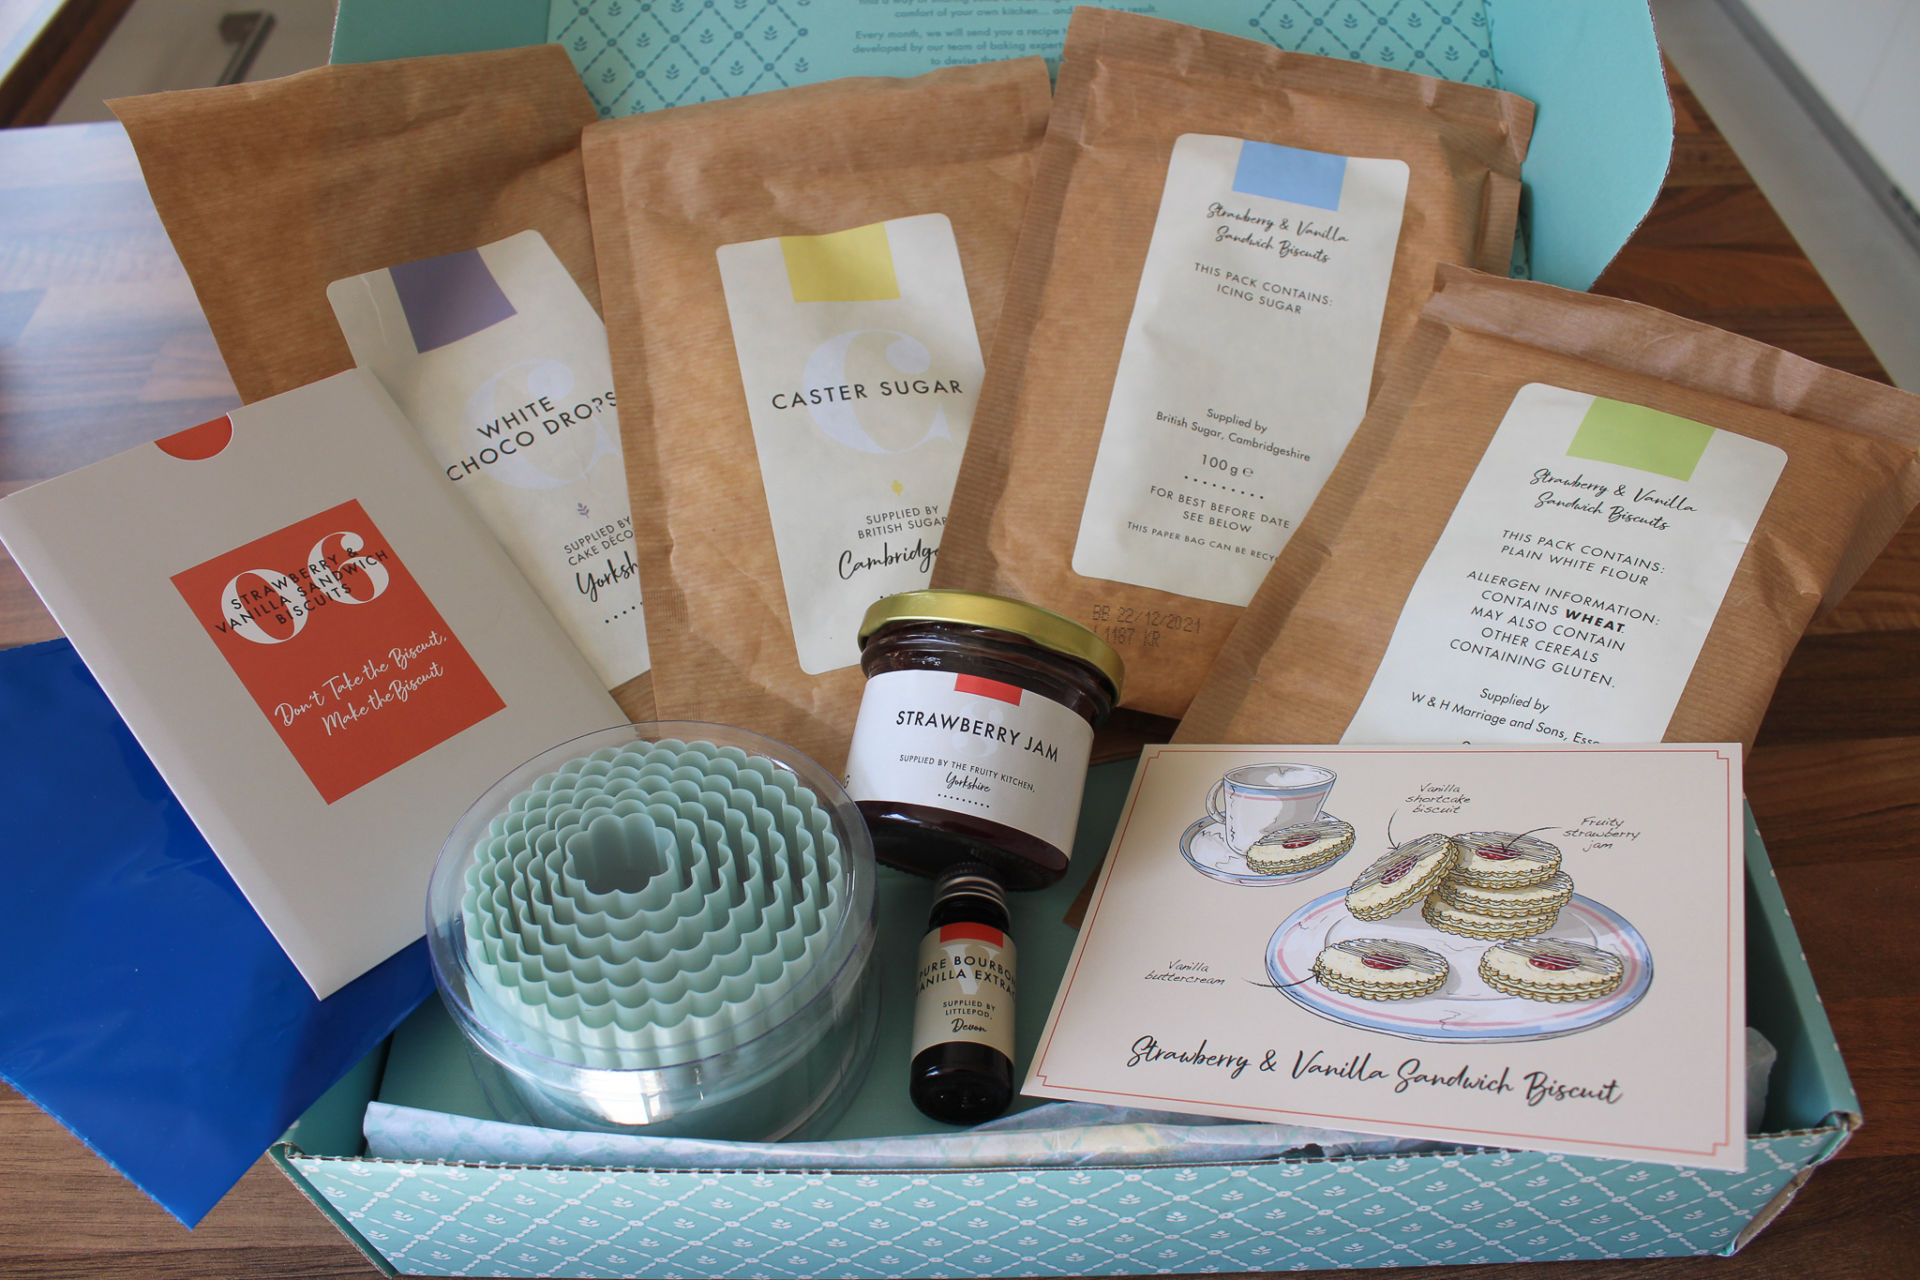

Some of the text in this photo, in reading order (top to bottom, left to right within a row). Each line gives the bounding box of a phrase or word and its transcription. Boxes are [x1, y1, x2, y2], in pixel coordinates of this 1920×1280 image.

[852, 42, 907, 54] developed
[910, 42, 923, 53] by
[990, 41, 1026, 52] baking
[855, 30, 884, 41] Every
[994, 29, 1013, 38] you
[1026, 27, 1059, 38] recipe
[1206, 201, 1349, 242] Strawberry & Vanilla
[1215, 225, 1331, 263] Sandwich Biscuits
[1194, 261, 1333, 306] THIS PACK CONTAINS:
[1217, 283, 1302, 314] ICING SUGAR
[772, 380, 963, 410] CASTER SUGAR
[476, 396, 555, 439] WHITE
[1206, 408, 1268, 434] Supplied by
[1156, 411, 1311, 462] British Sugar, Cambridgeshire
[446, 431, 535, 481] CHOCO
[1150, 485, 1290, 529] FOR BEST BEFORE DATE
[1530, 468, 1698, 512] Strawberry & Vanilla
[866, 505, 939, 525] SUPPLIED BY
[1183, 510, 1252, 534] SEE BELOW
[1534, 491, 1671, 531] Sandwich Biscuits
[564, 516, 631, 554] SUPPLIED BY
[858, 523, 903, 539] BRITISH
[1127, 521, 1148, 534] THIS
[1151, 528, 1181, 541] PAPER
[1184, 535, 1206, 547] BAG
[1209, 540, 1232, 552] CAN
[1235, 546, 1246, 555] BE
[568, 545, 600, 566] CAKE
[1500, 545, 1649, 586] PLAIN WHITE FLOUR
[1502, 529, 1665, 574] THIS PACK CONTAINS:
[215, 549, 388, 634] VANILLA SANDWICH
[231, 547, 358, 610] STRAWBERRY &
[576, 551, 638, 602] Yorksh
[275, 583, 352, 625] BISCUITS
[1466, 570, 1661, 626] ALLERGEN INFORMATION:
[1481, 590, 1559, 616] CONTAINS
[1470, 605, 1626, 652] MAY ALSO CONTAIN
[1481, 627, 1599, 664] OTHER CEREALS
[1450, 638, 1616, 688] CONTAINING GLUTEN.
[274, 690, 325, 727] Don't
[321, 672, 364, 700] Take
[363, 659, 389, 681] the
[321, 661, 444, 736] Make the Biscuit
[1479, 687, 1550, 714] Supplied by
[1411, 691, 1426, 704] W
[1427, 697, 1437, 708] &
[1439, 700, 1452, 712] H
[1452, 703, 1507, 726] Marriage
[1509, 718, 1534, 732] and
[1536, 721, 1568, 742] Sons,
[896, 710, 1059, 763] STRAWBERRY JAM
[899, 754, 935, 765] SUPPLIED
[937, 758, 949, 767] BY
[951, 761, 967, 771] THE
[970, 765, 999, 780] FRUITY
[945, 771, 991, 793] Yorkshire
[1404, 794, 1472, 804] shortcake
[1420, 783, 1461, 793] Vanilla
[1412, 804, 1461, 814] biscuit
[1580, 816, 1625, 828] Fruity
[1563, 828, 1641, 841] strawberry
[1583, 841, 1613, 852] jam
[920, 958, 946, 980] PURE
[1144, 970, 1226, 986] buttercream
[1169, 959, 1209, 972] Vanilla
[943, 999, 996, 1011] SUPPLIED BY
[951, 1018, 987, 1033] Devon
[1127, 1035, 1624, 1107] Strawberry & Vanilla Sandwich Biscuit
